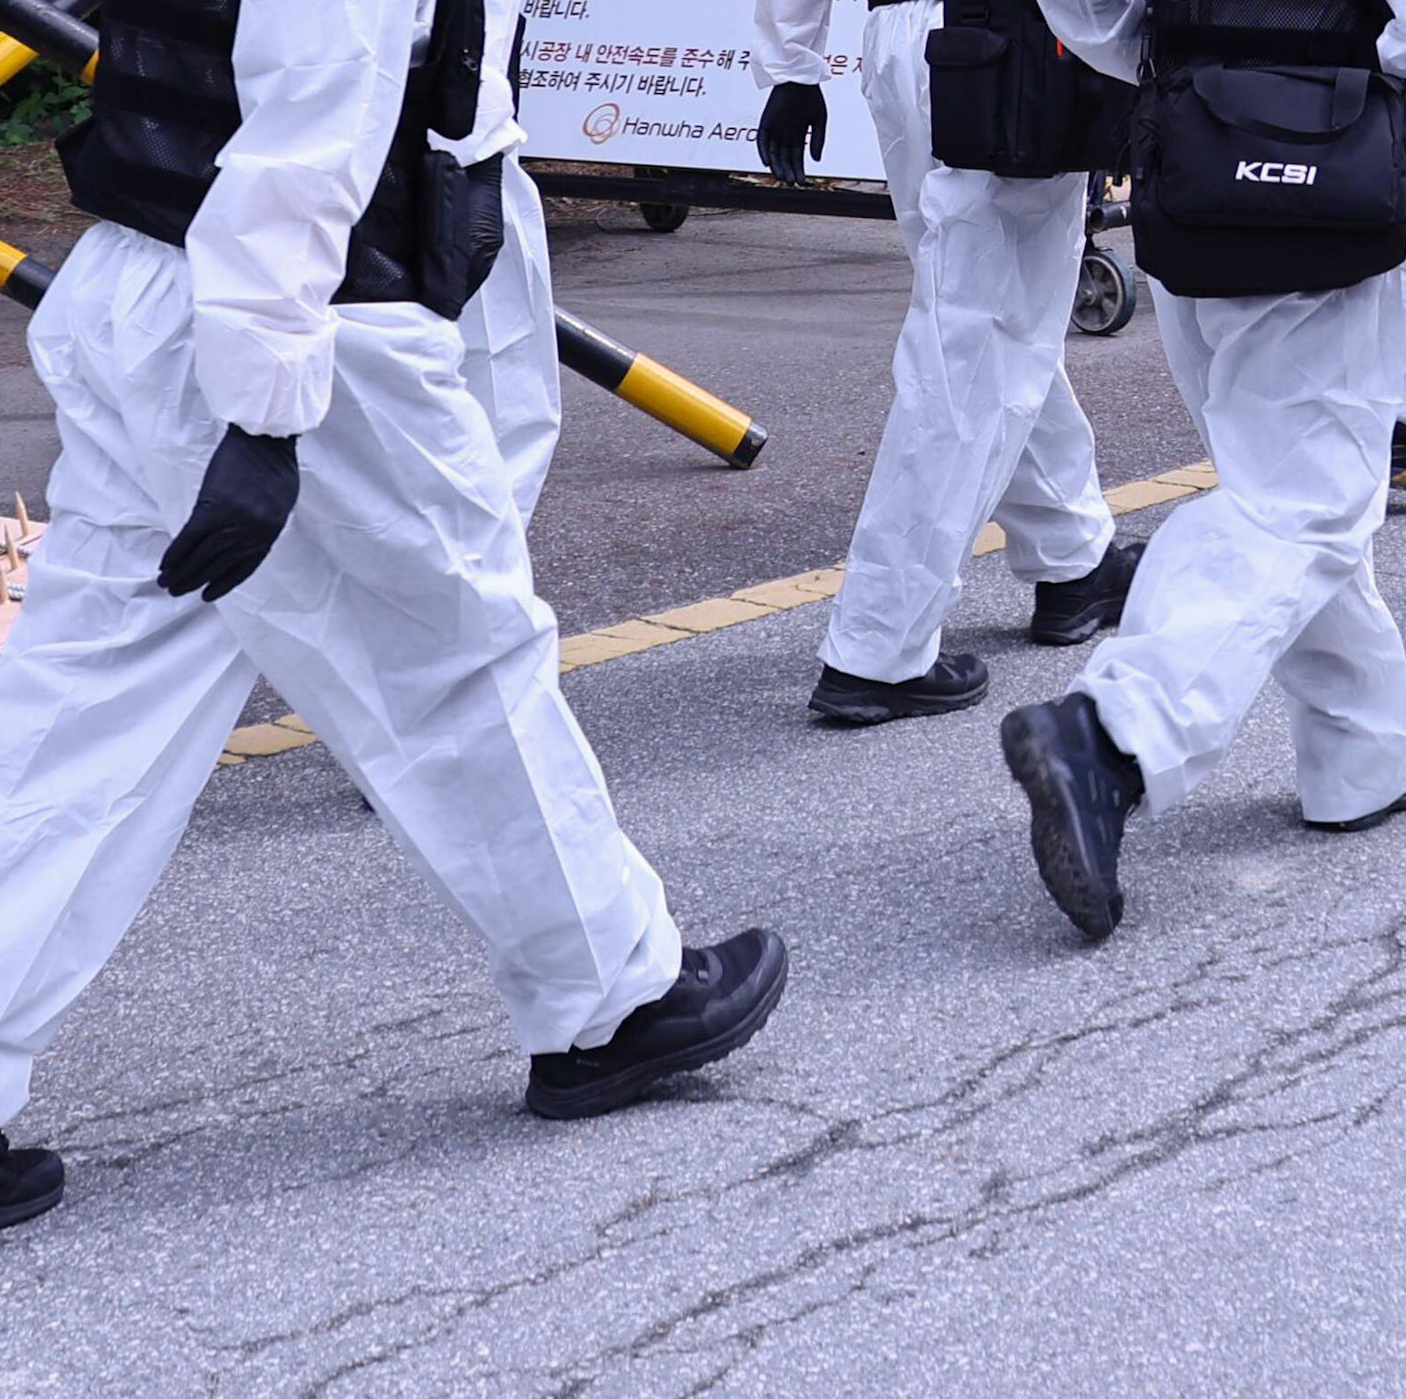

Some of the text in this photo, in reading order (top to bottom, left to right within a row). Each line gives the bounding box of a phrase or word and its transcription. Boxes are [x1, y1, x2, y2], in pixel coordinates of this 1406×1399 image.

[576, 43, 593, 63] 내
[596, 44, 677, 67] 안전속도를
[519, 69, 707, 98] 협조하여 주시기 바랍니다.
[622, 117, 705, 139] Hanwha
[1235, 161, 1318, 185] KCSI
